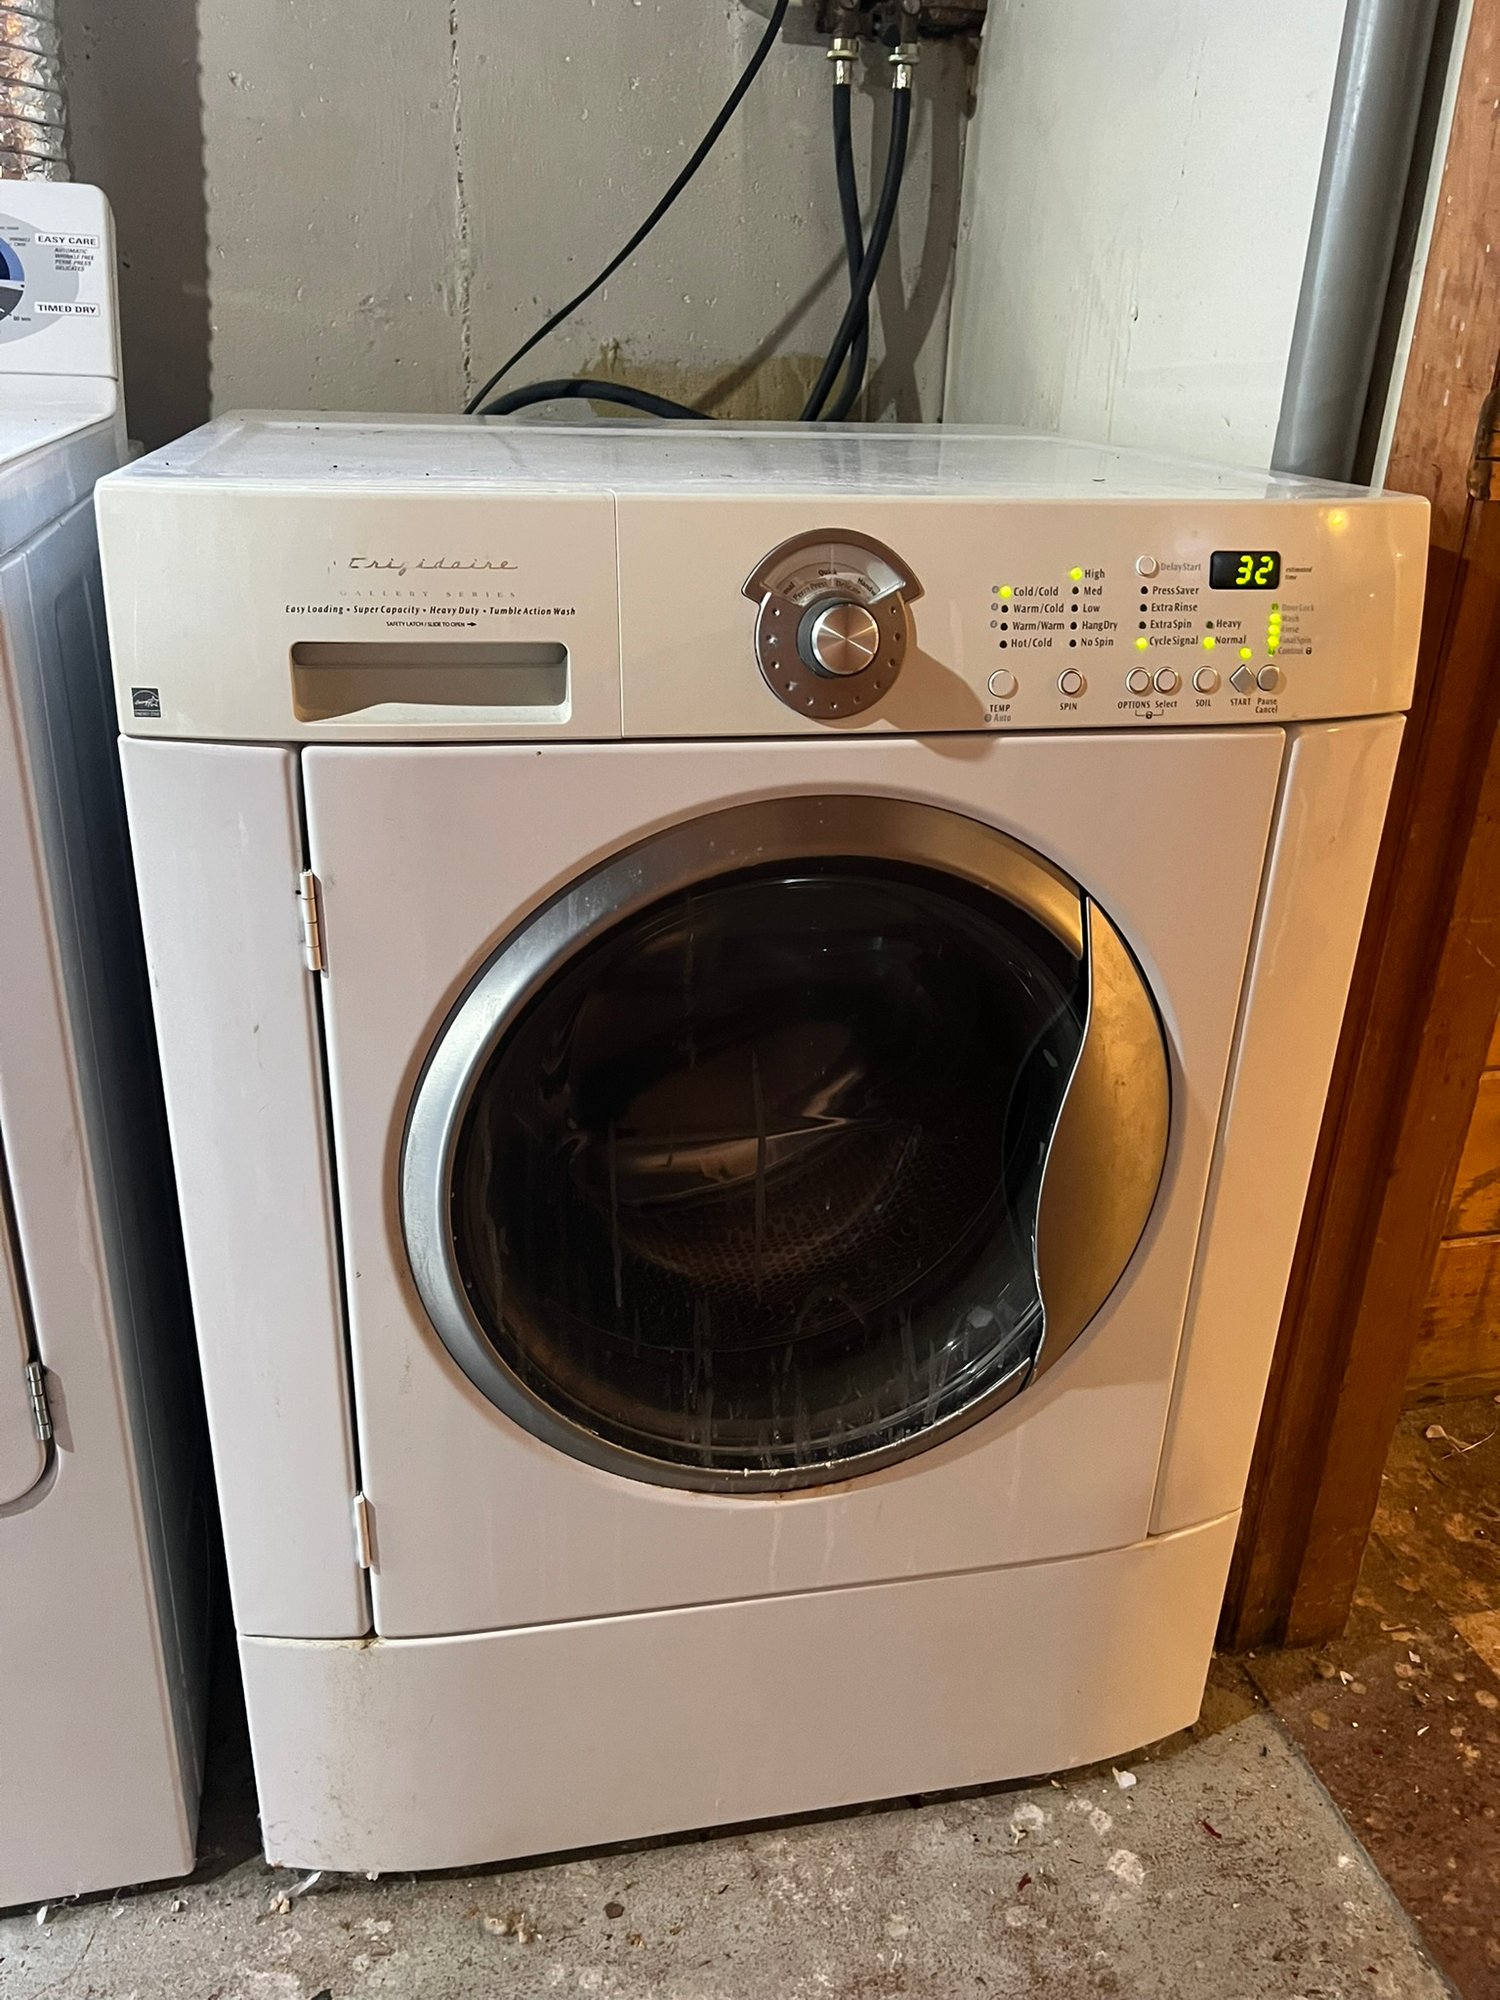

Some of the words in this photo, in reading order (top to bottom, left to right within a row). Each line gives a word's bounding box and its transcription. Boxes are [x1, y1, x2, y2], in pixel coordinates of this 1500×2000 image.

[38, 235, 66, 244] EASY
[68, 236, 97, 246] CARE
[37, 304, 72, 313] TIMED
[74, 305, 96, 314] DRY
[349, 557, 519, 577] Frigidaire
[1161, 562, 1183, 573] Delay
[1182, 562, 1202, 571] Start
[1235, 554, 1275, 586] 32
[1084, 568, 1106, 580] High
[1013, 586, 1059, 597] Cold/Cold
[1083, 586, 1103, 596] Med
[1152, 585, 1175, 595] Press
[1175, 585, 1200, 595] Saver
[285, 604, 306, 615] Easy
[307, 604, 344, 615] Loading
[353, 605, 379, 616] Super
[380, 605, 420, 616] Capacity
[430, 606, 457, 617] Heavy
[458, 606, 480, 617] Duty
[489, 607, 521, 616] Tumble
[522, 607, 552, 616] Action
[553, 607, 577, 616] Wash
[1013, 603, 1065, 613] Warm/Cold
[1082, 603, 1100, 613] Low
[1151, 602, 1173, 612] Extra
[1174, 602, 1198, 612] Rinse
[1012, 620, 1065, 631] Warm/Warm
[1081, 620, 1104, 632] Hang
[1103, 620, 1118, 632] Dry
[1150, 619, 1172, 629] Extra
[1173, 618, 1192, 630] Spin
[1216, 618, 1242, 630] Heavy
[1010, 638, 1053, 649] Hot/Cold
[1080, 637, 1093, 647] No
[1094, 637, 1114, 648] Spin
[1149, 635, 1172, 647] Cycle
[1172, 634, 1199, 647] Signal
[1215, 634, 1246, 644] Normal
[1117, 700, 1151, 709] OPTIONS
[1155, 699, 1178, 708] Select
[1195, 699, 1212, 707] SOIL
[1230, 697, 1251, 706] START
[1257, 697, 1277, 705] Pause
[989, 704, 1011, 712] TEMP
[1059, 703, 1078, 711] SPIN
[1255, 705, 1278, 714] Cancel
[993, 714, 1012, 722] Auto
